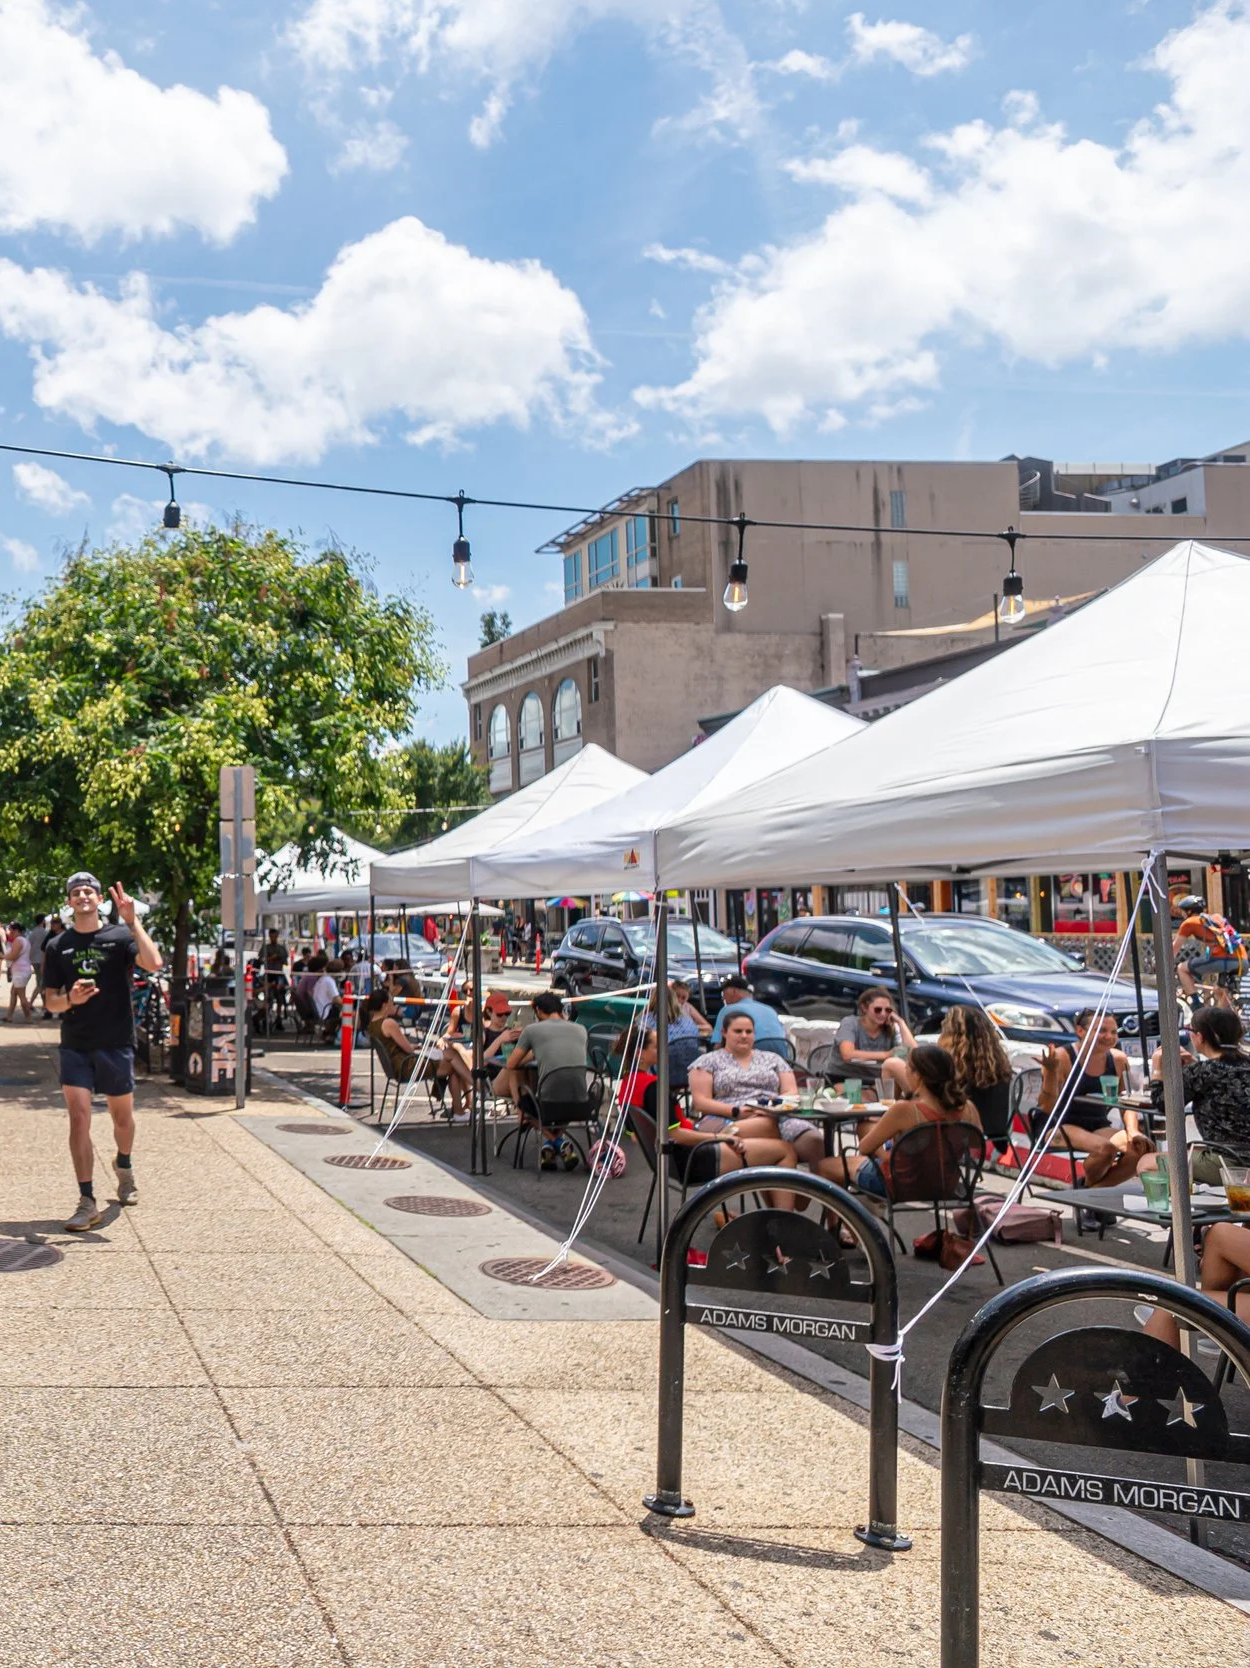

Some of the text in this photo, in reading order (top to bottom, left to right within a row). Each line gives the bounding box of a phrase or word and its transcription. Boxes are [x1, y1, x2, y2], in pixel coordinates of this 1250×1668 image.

[700, 1309, 856, 1341] ADAMS MORGAN
[1003, 1470, 1240, 1519] ADAMS MORGAN
